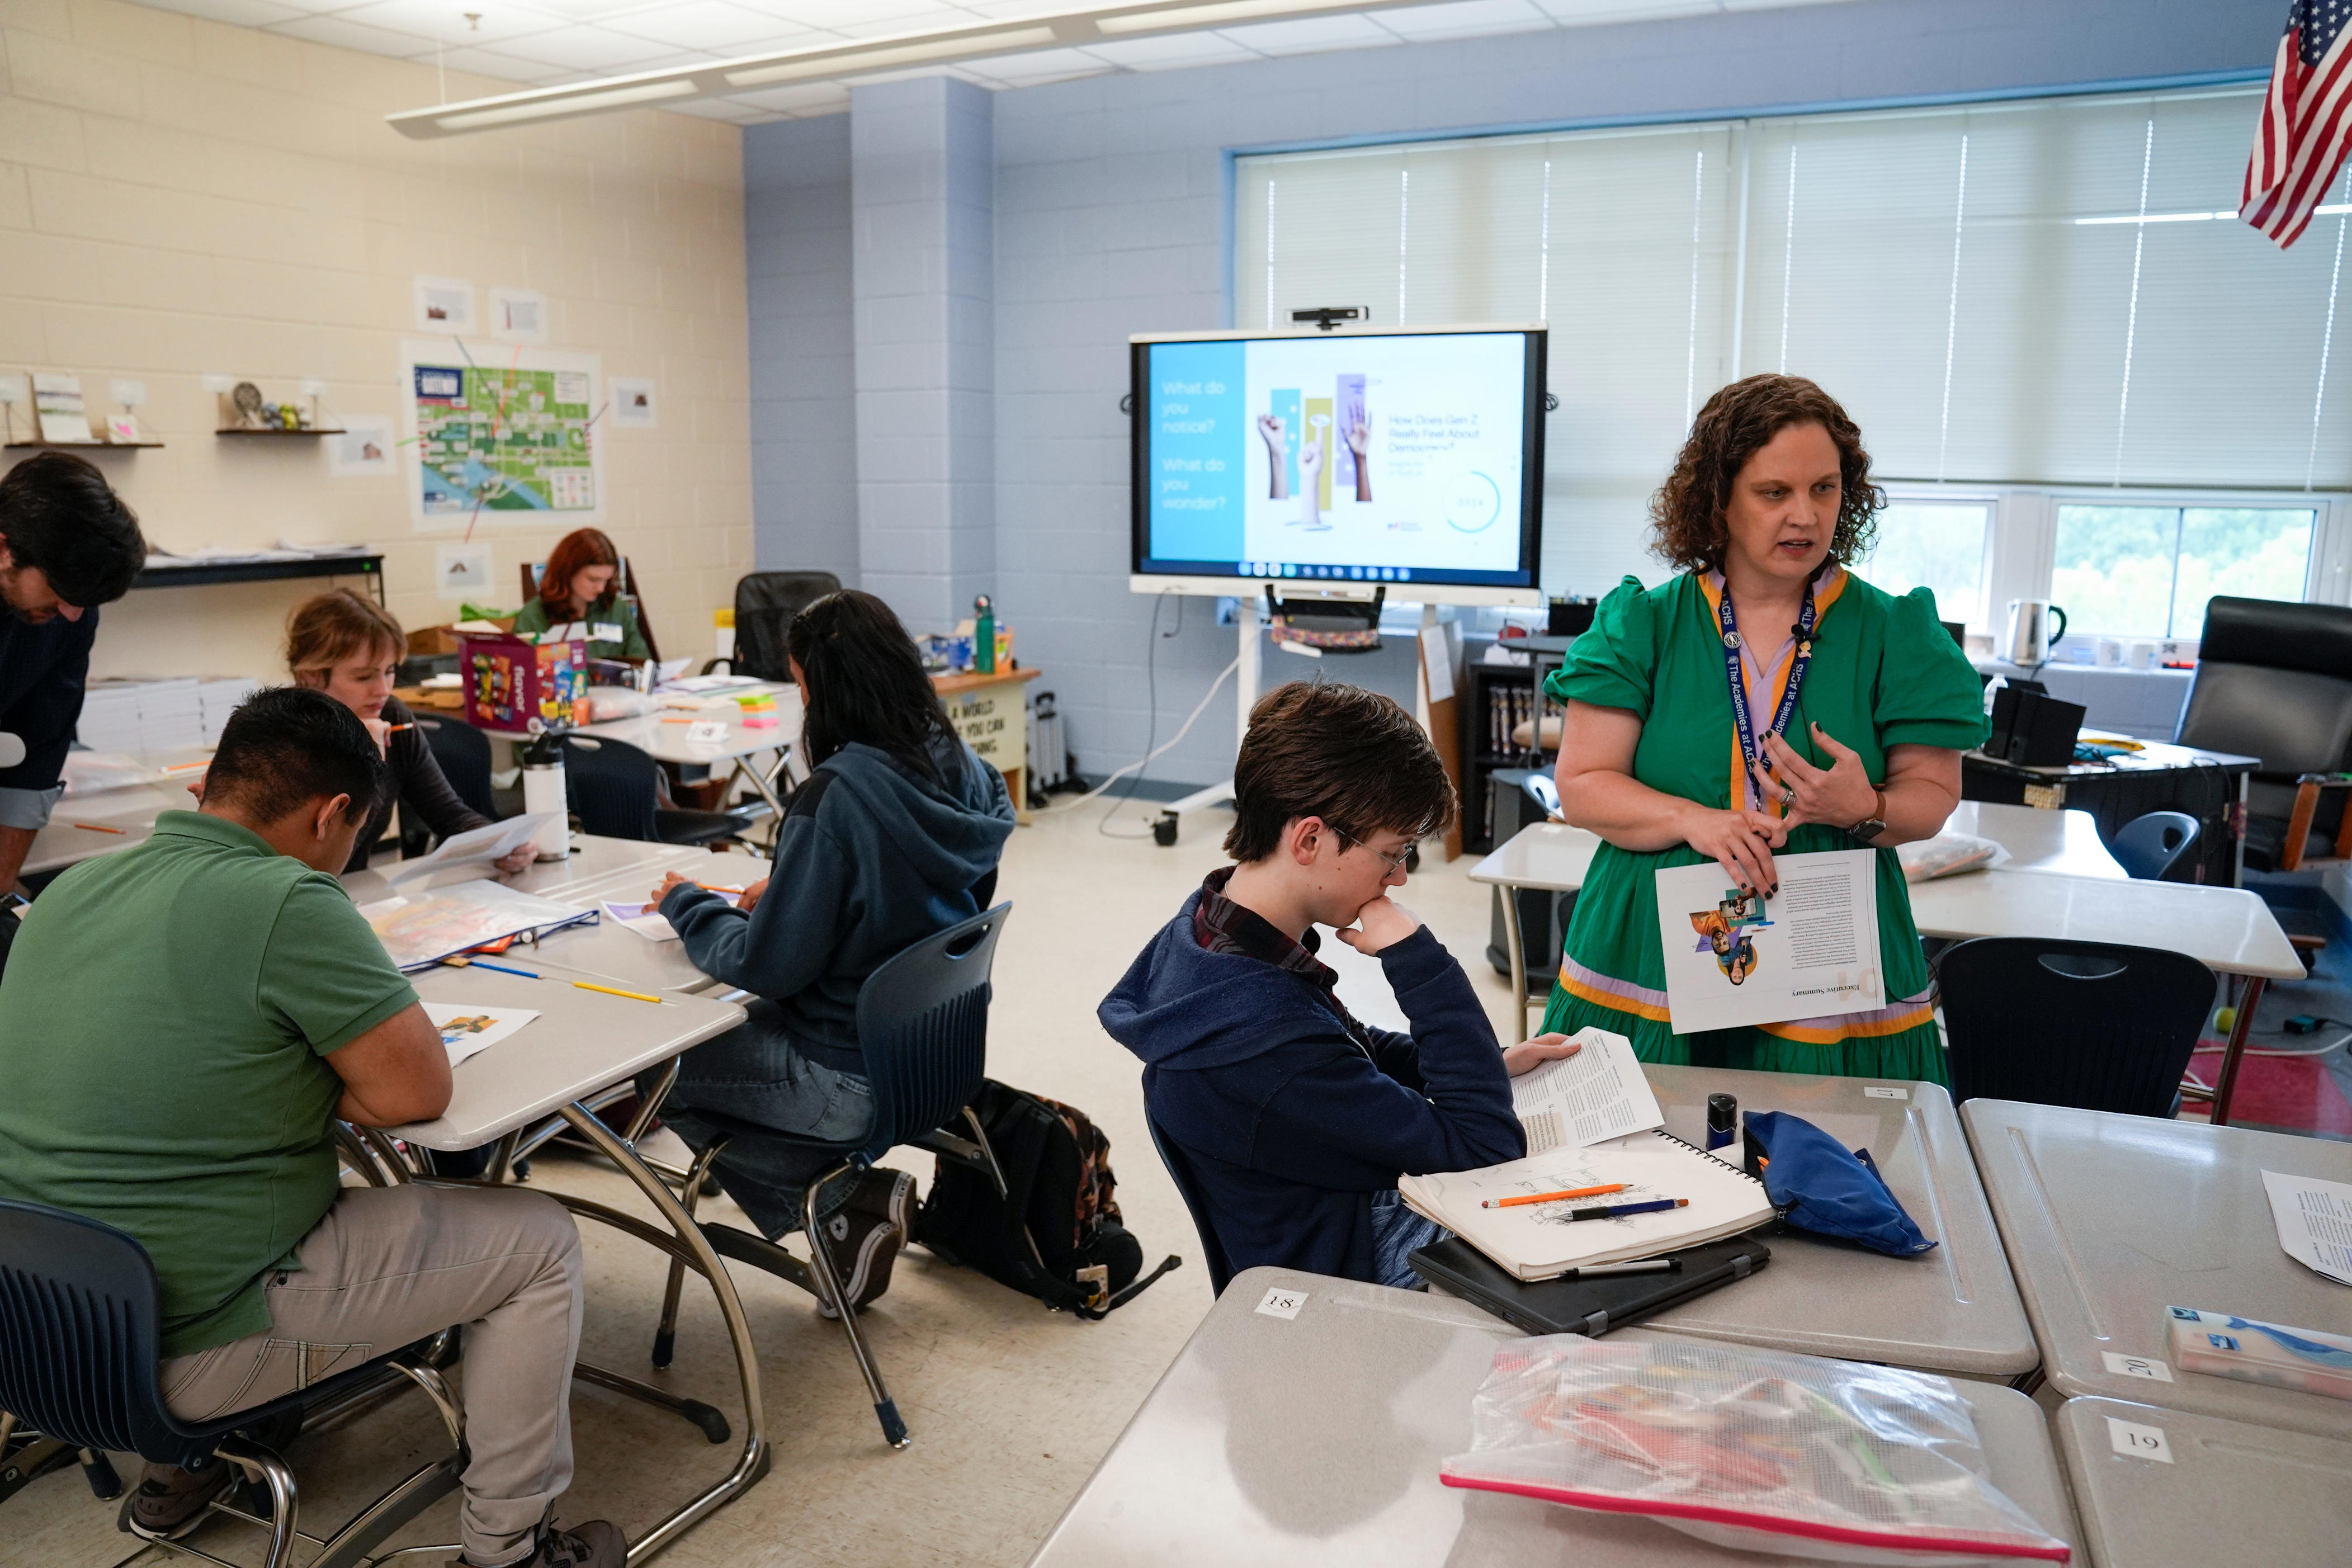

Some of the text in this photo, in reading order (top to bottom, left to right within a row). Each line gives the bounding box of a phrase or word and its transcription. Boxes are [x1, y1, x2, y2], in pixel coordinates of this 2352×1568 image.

[1161, 380, 1226, 395] What do
[1161, 403, 1189, 418] you
[1161, 419, 1215, 433] notice?
[1389, 414, 1478, 425] How Does Gen Z
[1388, 428, 1480, 440] Really Feel About
[1161, 457, 1226, 471] What do
[1161, 479, 1189, 494] you
[1161, 495, 1226, 510] wonder?
[1721, 600, 1732, 625] ACHS
[1802, 607, 1813, 622] The
[1730, 665, 1738, 682] The
[962, 699, 994, 717] WORLD
[1732, 683, 1748, 731] Academies
[1775, 702, 1792, 735] demies
[1788, 691, 1797, 700] at
[966, 721, 983, 737] YOU
[986, 717, 1005, 734] CAN
[1742, 734, 1750, 744] at
[1792, 984, 1859, 996] Executive Summary
[1269, 1296, 1293, 1308] 18
[2126, 1359, 2152, 1376] 20
[2127, 1433, 2159, 1449] 19
